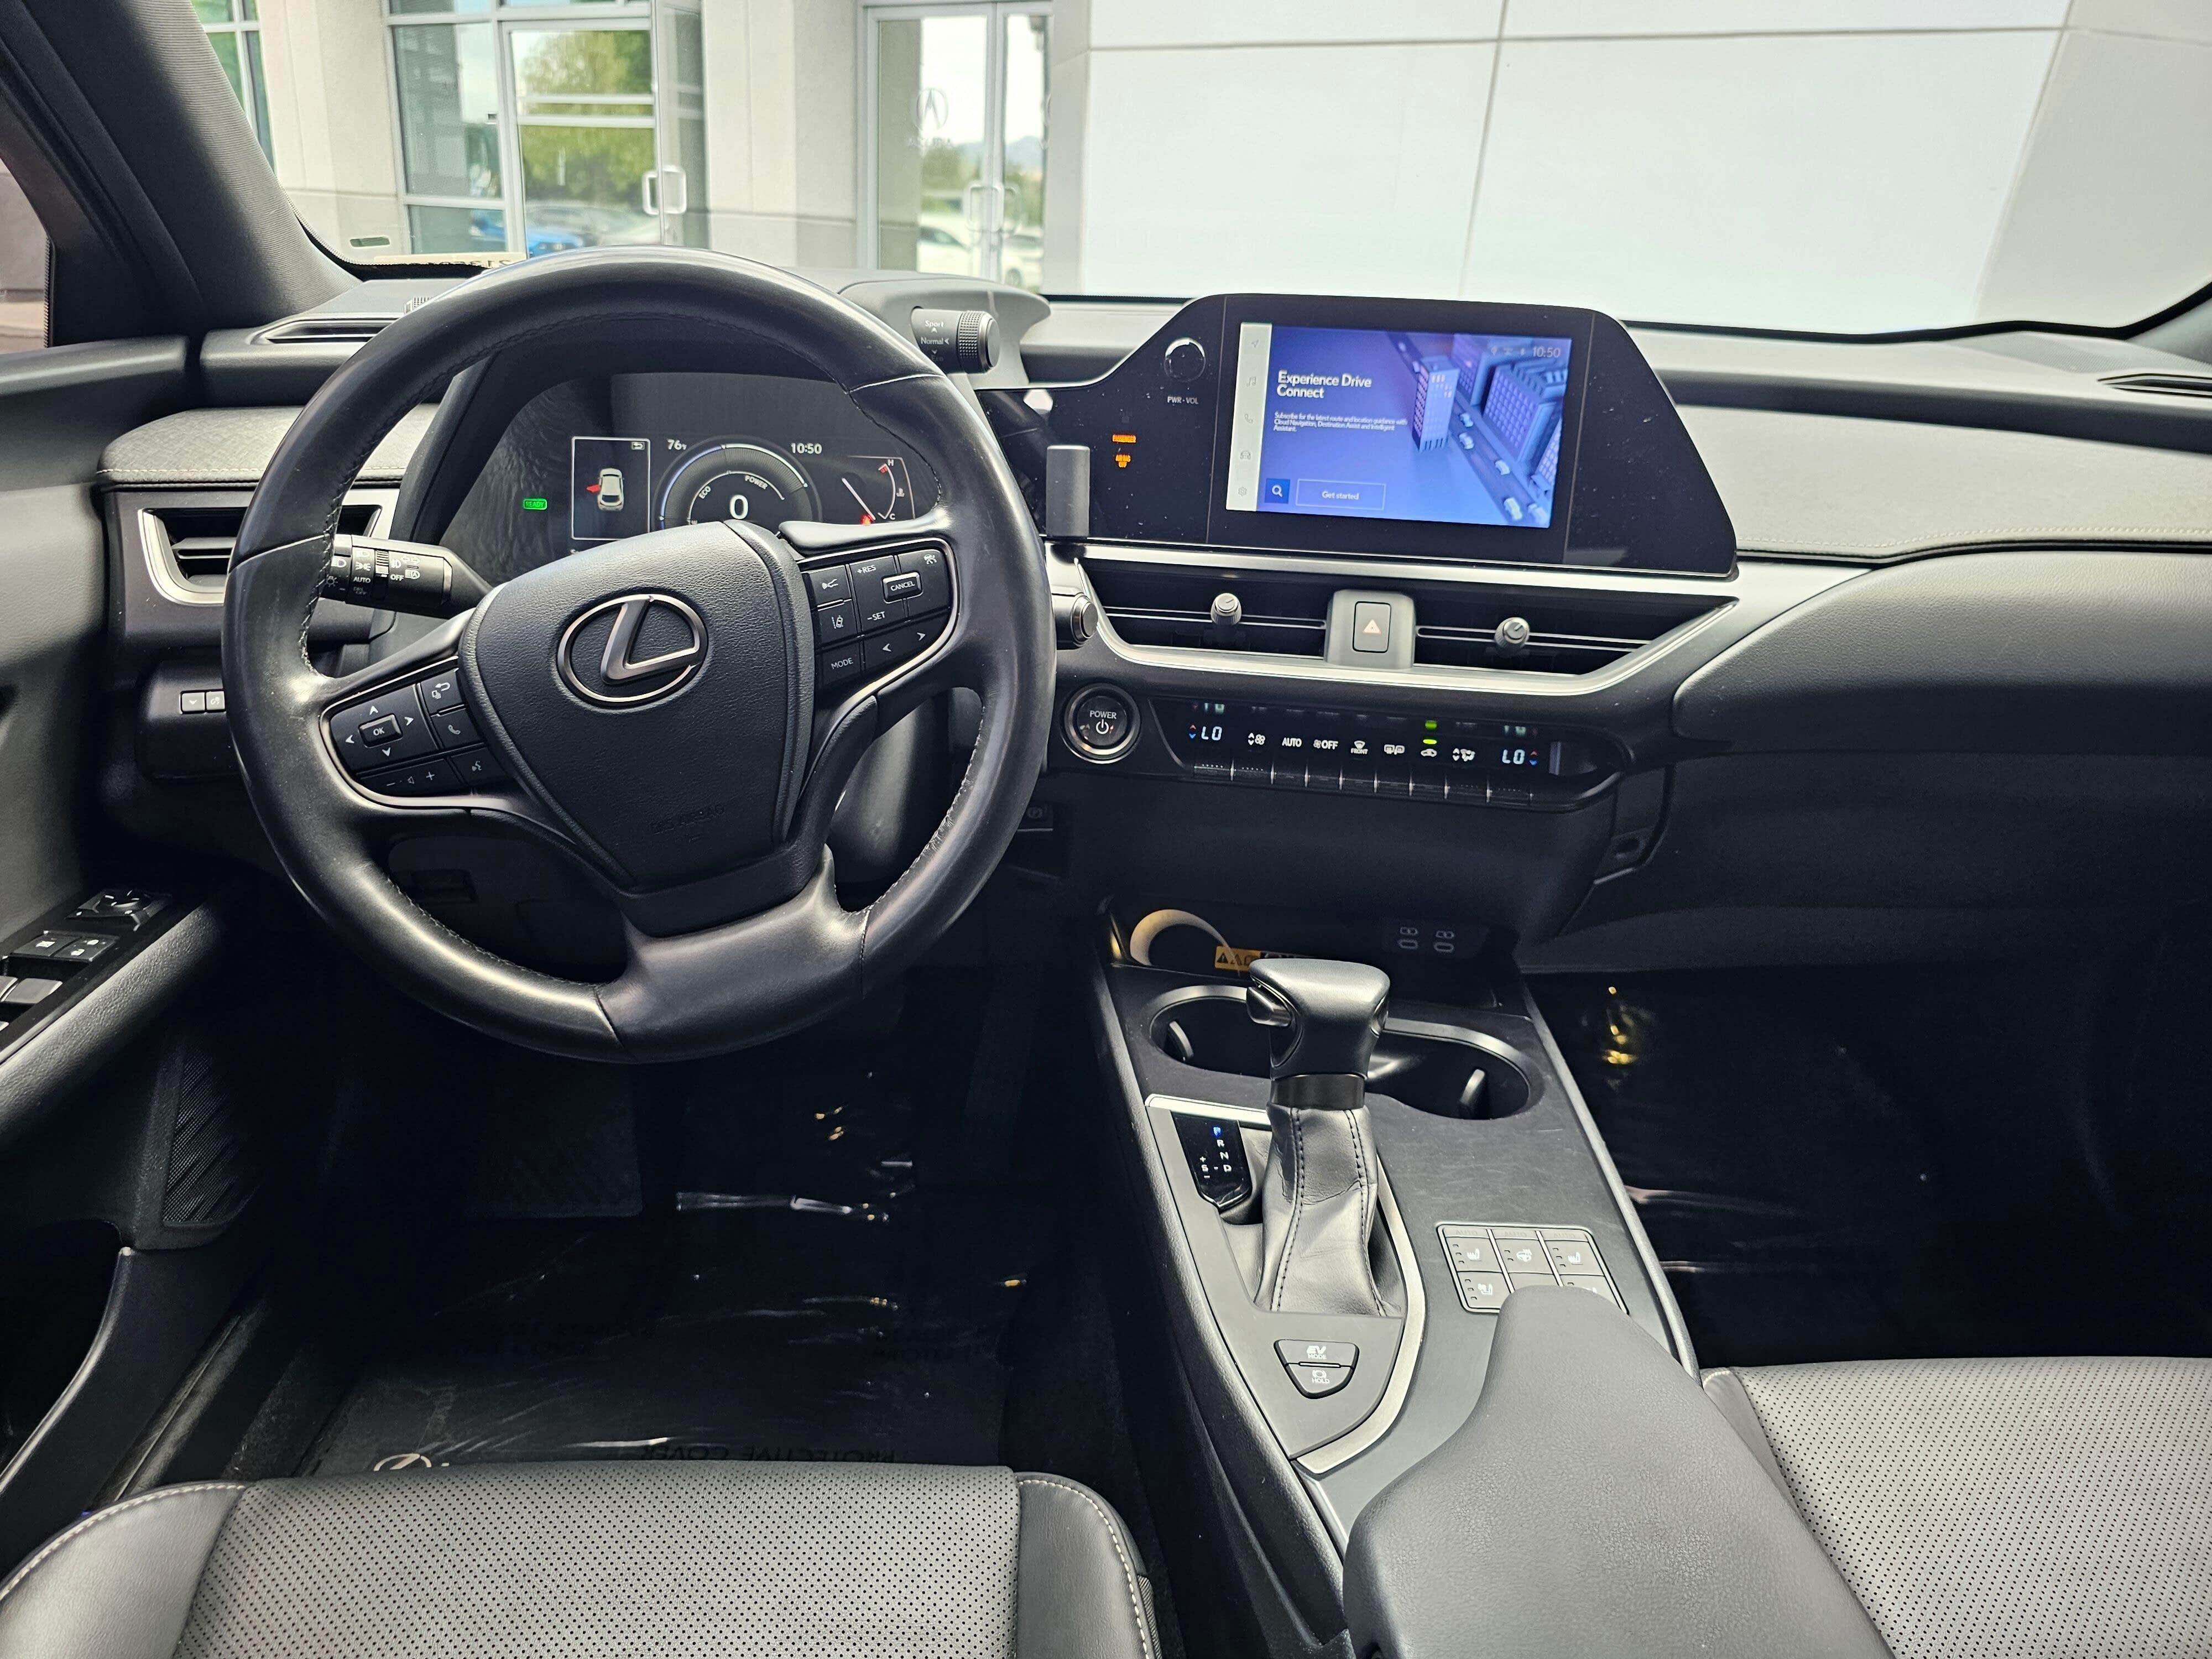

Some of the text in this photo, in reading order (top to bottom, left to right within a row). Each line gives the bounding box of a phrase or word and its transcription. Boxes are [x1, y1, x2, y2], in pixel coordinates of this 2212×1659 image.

[920, 336, 944, 345] Normal
[1533, 346, 1561, 358] 10:50
[1277, 370, 1372, 387] Experience Drive
[1276, 384, 1324, 398] Connect
[1274, 411, 1298, 420] Subscribe
[1290, 419, 1317, 427] Navigation,
[1370, 423, 1395, 431] Intelligent
[791, 443, 822, 454] 10:50
[744, 475, 768, 490] POWER
[698, 486, 711, 499] ECO
[729, 494, 749, 520] 0
[890, 582, 915, 591] CANCEL
[831, 658, 854, 669] MODE
[1089, 711, 1117, 719] POWER
[373, 726, 385, 736] OK
[1201, 726, 1223, 741] LO
[1282, 737, 1302, 748] AUTO
[1321, 739, 1338, 749] OFF
[1501, 749, 1525, 765] LO
[1217, 1139, 1225, 1147] R
[1220, 1151, 1229, 1160] N
[1201, 1164, 1232, 1172] S D
[1306, 1345, 1327, 1354] EV
